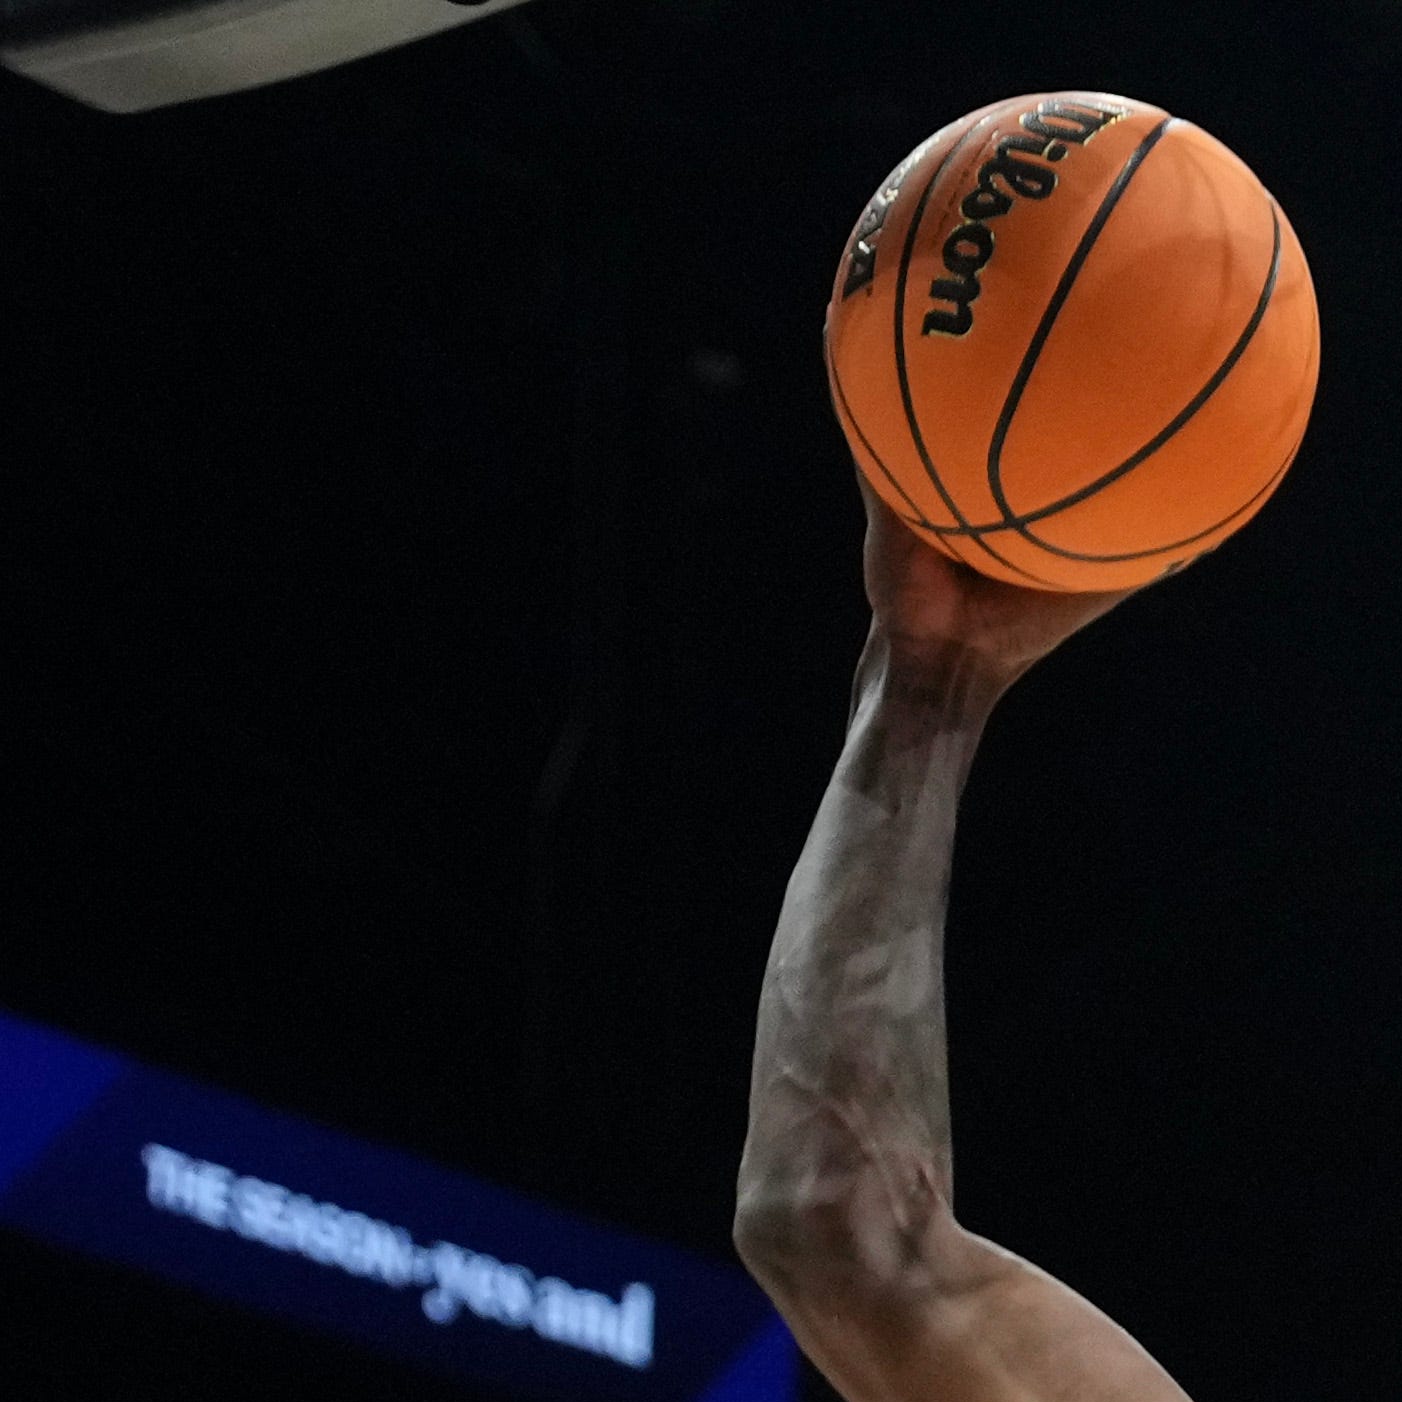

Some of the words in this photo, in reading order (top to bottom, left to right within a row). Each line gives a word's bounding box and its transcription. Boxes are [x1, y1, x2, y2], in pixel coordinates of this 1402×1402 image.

[921, 99, 1132, 339] Wilson
[142, 1142, 236, 1233] THE
[230, 1174, 413, 1290] SEASON
[533, 1277, 655, 1369] and
